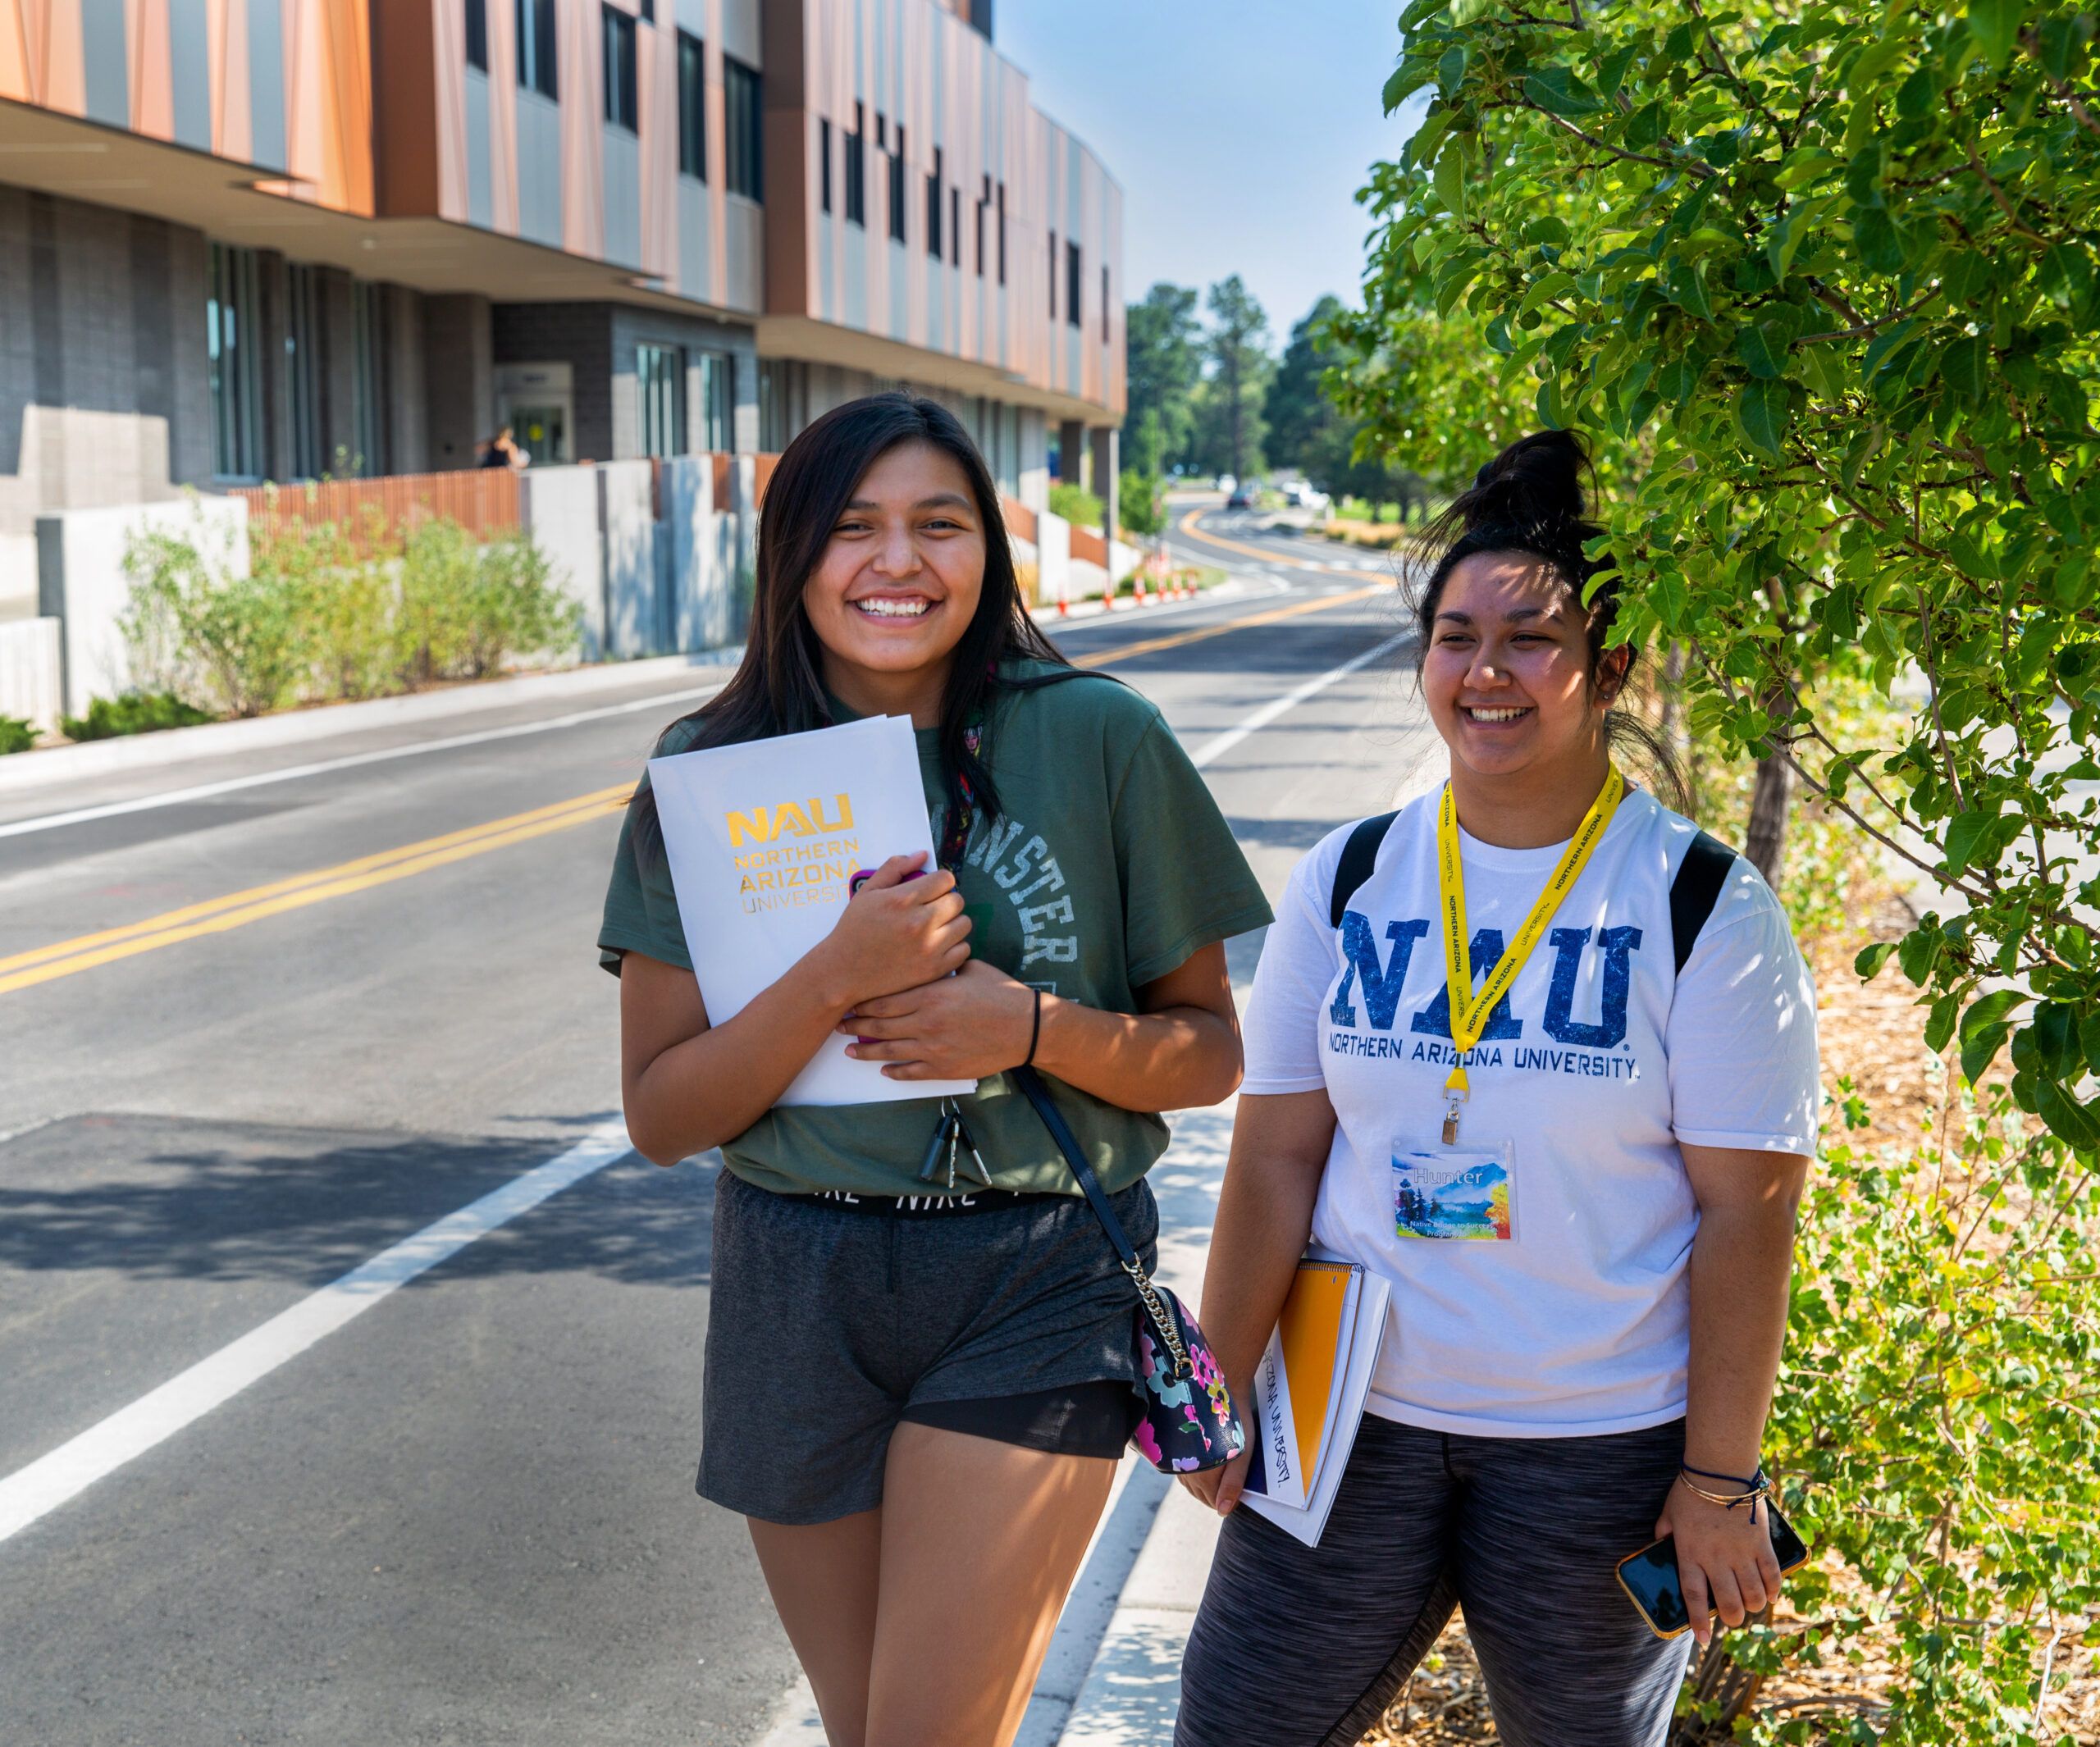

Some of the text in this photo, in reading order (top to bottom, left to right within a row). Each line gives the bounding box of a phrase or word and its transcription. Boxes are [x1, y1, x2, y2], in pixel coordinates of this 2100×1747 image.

[725, 792, 854, 848] NAU
[734, 837, 860, 871] NORTHERN
[1554, 814, 1602, 891] NORTHERN ARIZONA
[740, 858, 861, 895] ARIZONA
[742, 883, 850, 914] UNIVERSIT
[1449, 895, 1462, 974] NORTHERN ARIZONA
[1521, 904, 1548, 946] UNIVERSITY
[1330, 910, 1643, 1049] NAU
[1467, 957, 1518, 1033] NORTHERN ARIZONA
[1329, 1032, 1402, 1059] NORTHERN
[1514, 1047, 1637, 1079] UNIVERSITY
[1413, 1168, 1483, 1185] Hunter
